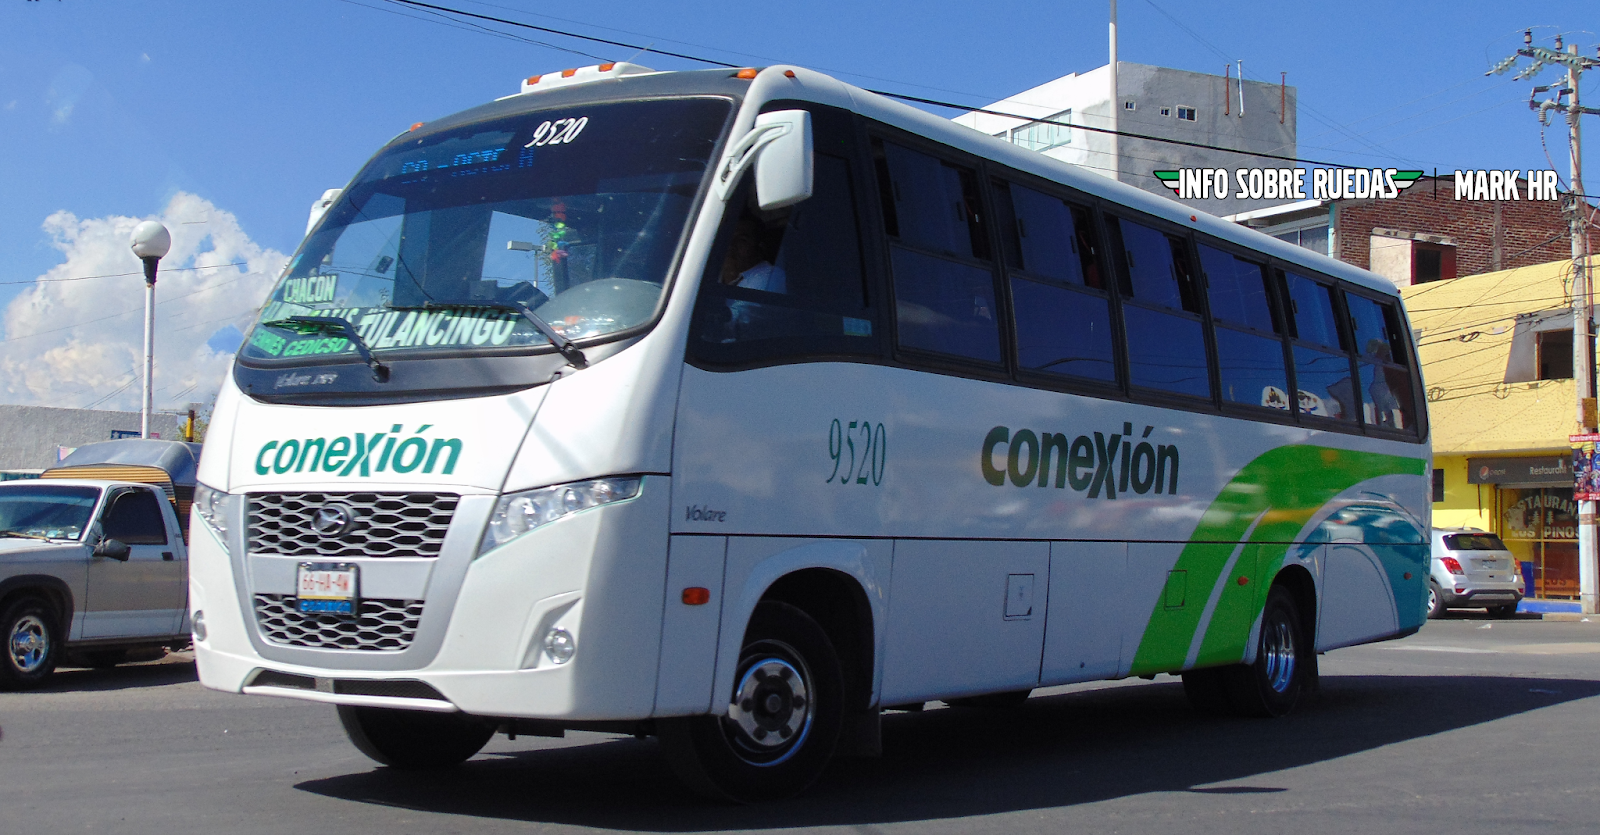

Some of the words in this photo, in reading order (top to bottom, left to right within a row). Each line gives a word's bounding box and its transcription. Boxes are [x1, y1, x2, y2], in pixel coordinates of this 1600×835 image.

[524, 116, 588, 148] 9520
[283, 275, 337, 302] CHACON
[357, 309, 516, 348] TULANCINGO
[825, 418, 887, 487] 9520
[685, 504, 727, 522] Volare
